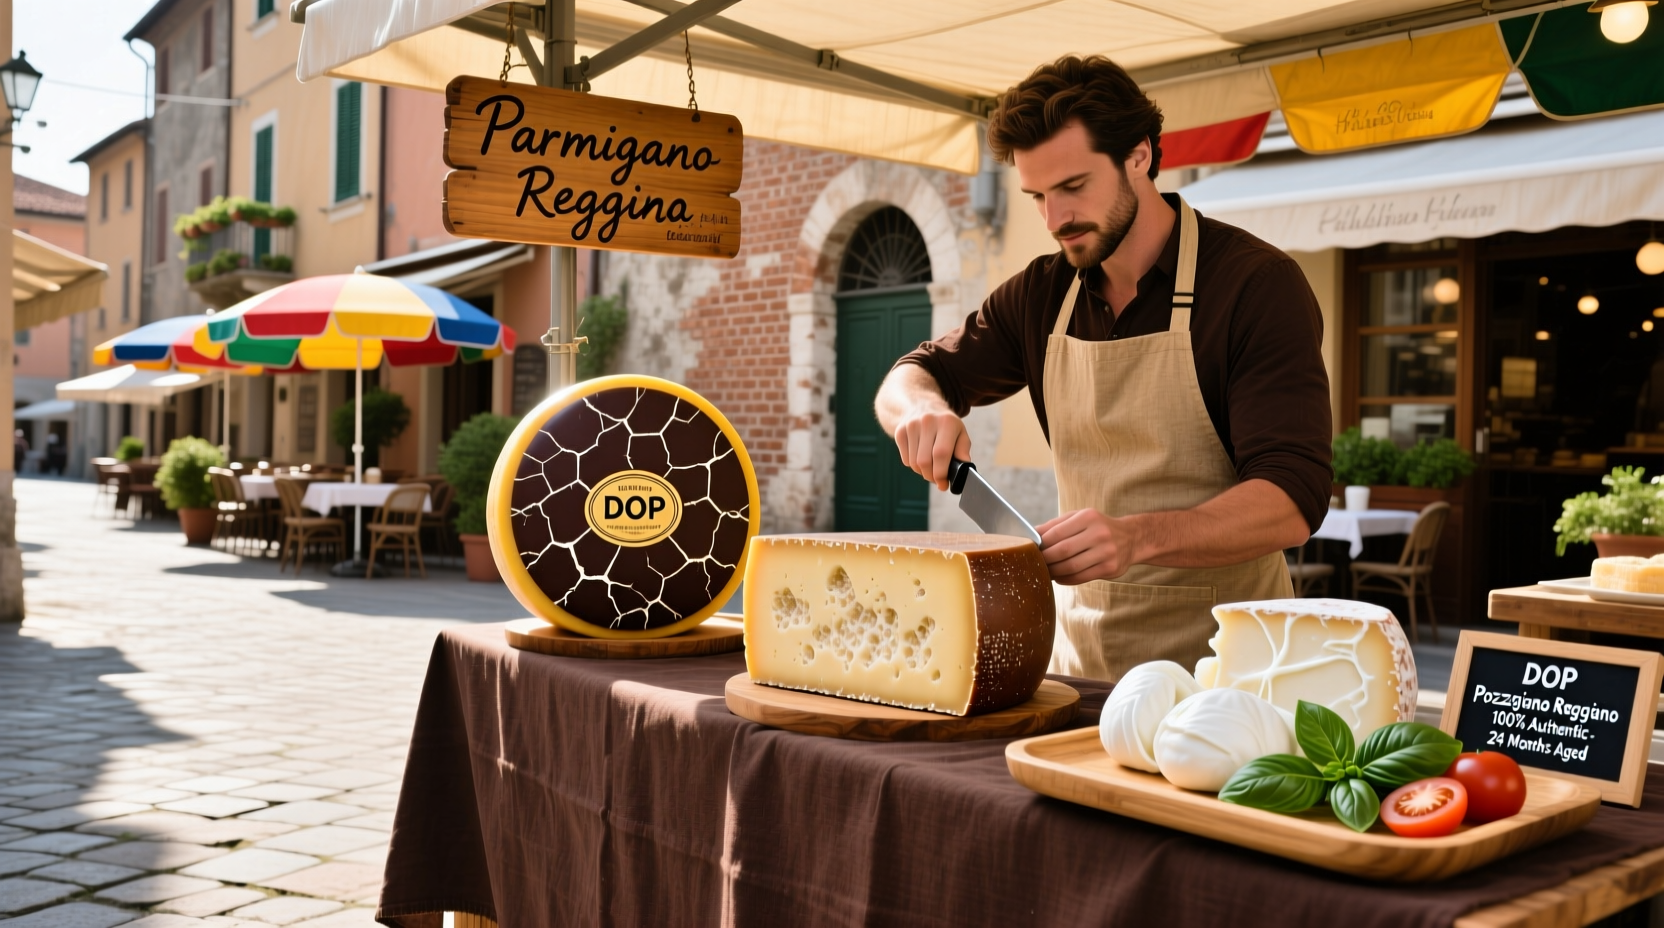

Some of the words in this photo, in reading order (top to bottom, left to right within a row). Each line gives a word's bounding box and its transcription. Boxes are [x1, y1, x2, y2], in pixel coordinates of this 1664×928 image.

[475, 95, 721, 186] Parmigano
[516, 165, 693, 243] Reggina
[604, 495, 666, 520] DOP
[1522, 662, 1578, 690] DOP
[1493, 710, 1526, 730] 100%
[1487, 730, 1505, 747] 24
[1553, 741, 1589, 762] Aged
